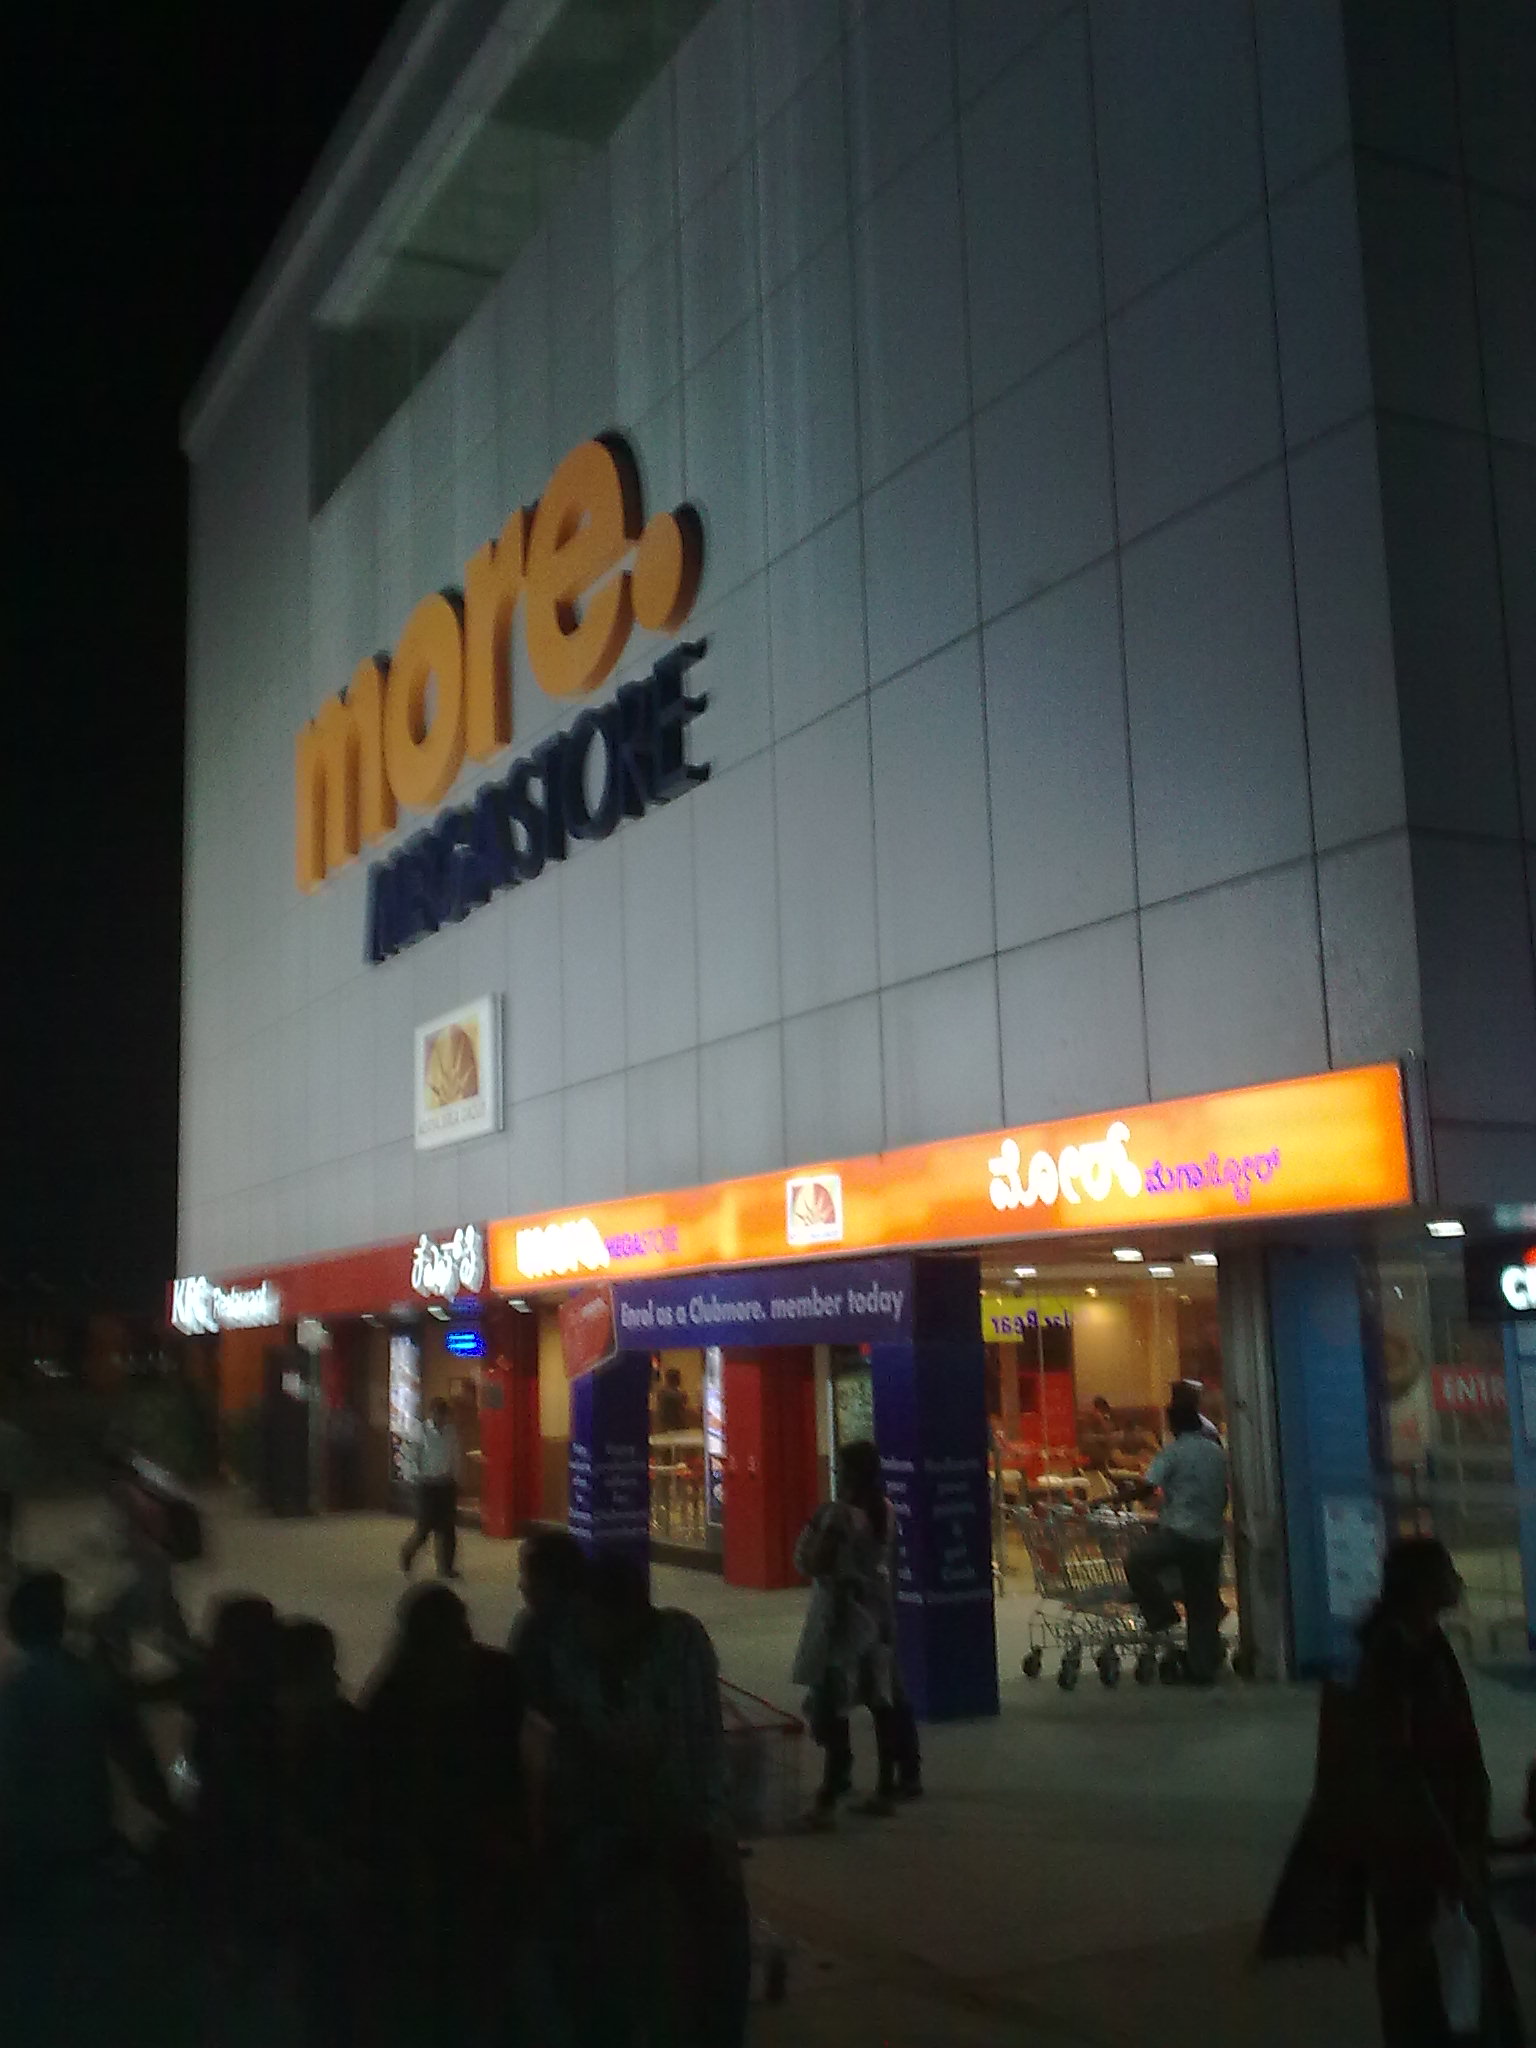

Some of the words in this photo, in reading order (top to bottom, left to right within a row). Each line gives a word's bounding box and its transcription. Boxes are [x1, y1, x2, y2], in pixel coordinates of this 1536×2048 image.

[295, 429, 706, 895] more.
[770, 1286, 844, 1320] member
[847, 1281, 904, 1323] today
